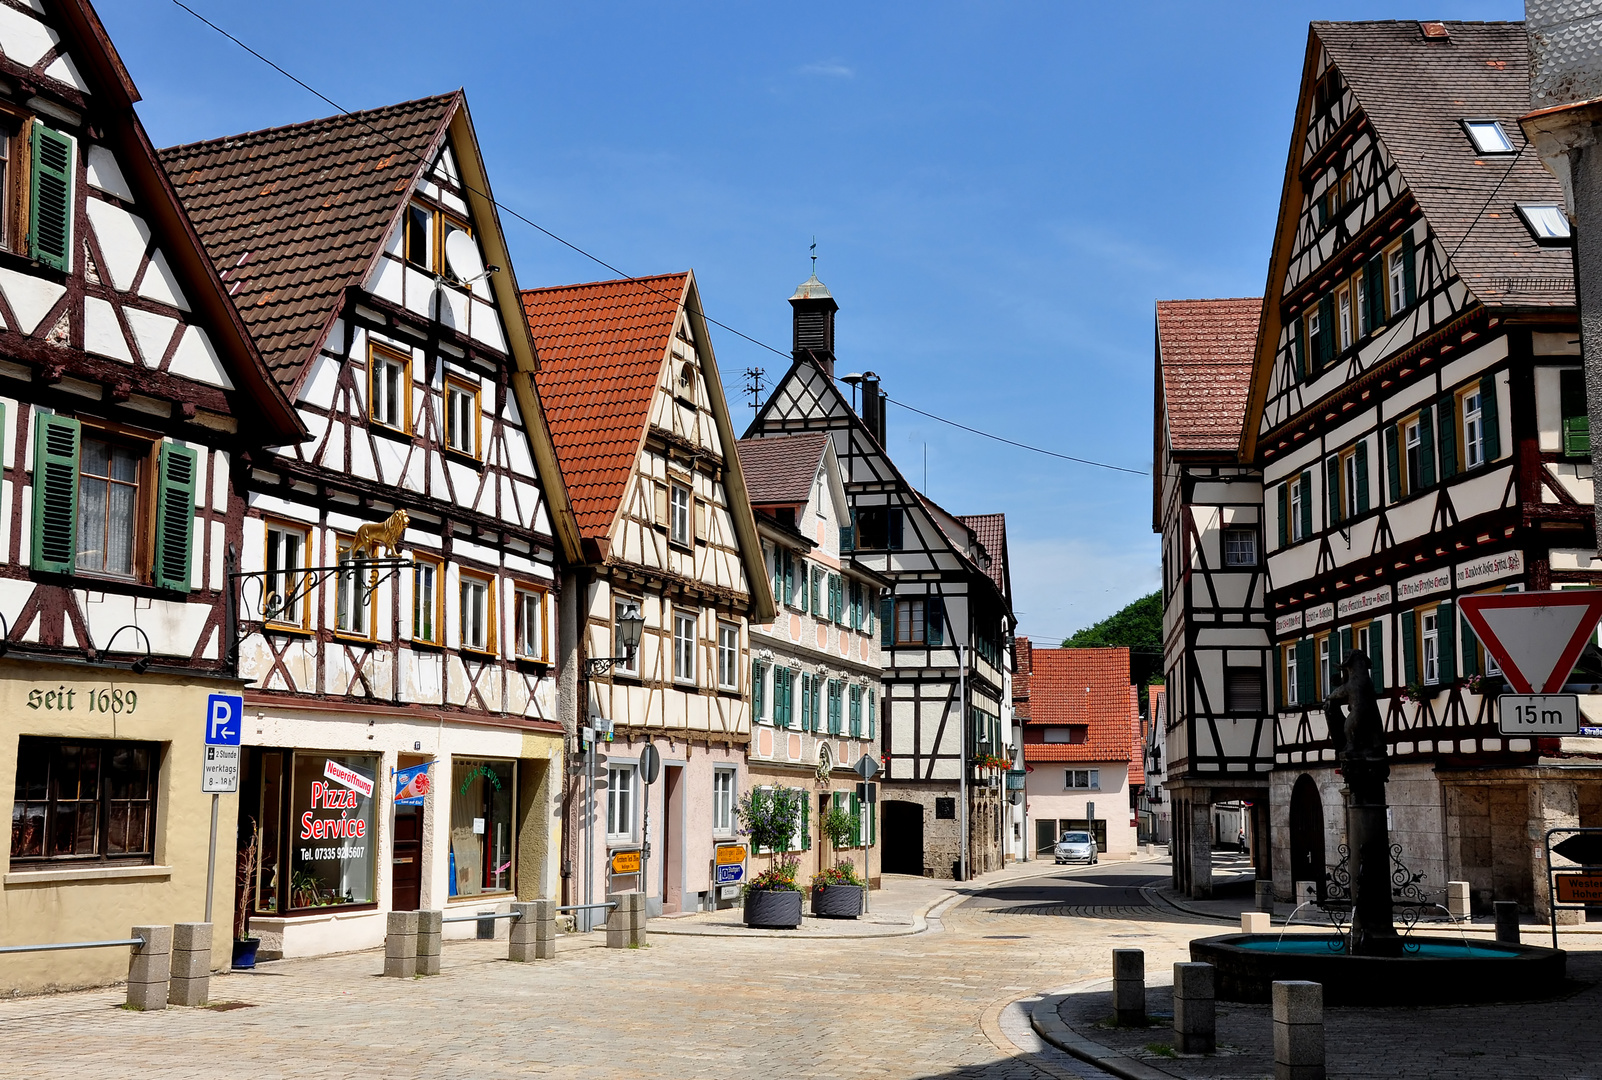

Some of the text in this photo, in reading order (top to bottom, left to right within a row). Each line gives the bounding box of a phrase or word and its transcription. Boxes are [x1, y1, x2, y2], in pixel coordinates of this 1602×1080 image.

[87, 688, 138, 714] 1689
[211, 700, 232, 739] P
[1514, 705, 1563, 725] 15 m
[215, 750, 219, 758] 2
[206, 764, 237, 774] werktags
[208, 777, 214, 786] 8
[327, 761, 372, 795] Neueröffnung
[480, 766, 502, 792] SERVICE
[311, 781, 357, 809] Pizza
[300, 810, 366, 840] Service
[300, 848, 314, 861] Tel.
[314, 848, 336, 860] 07335
